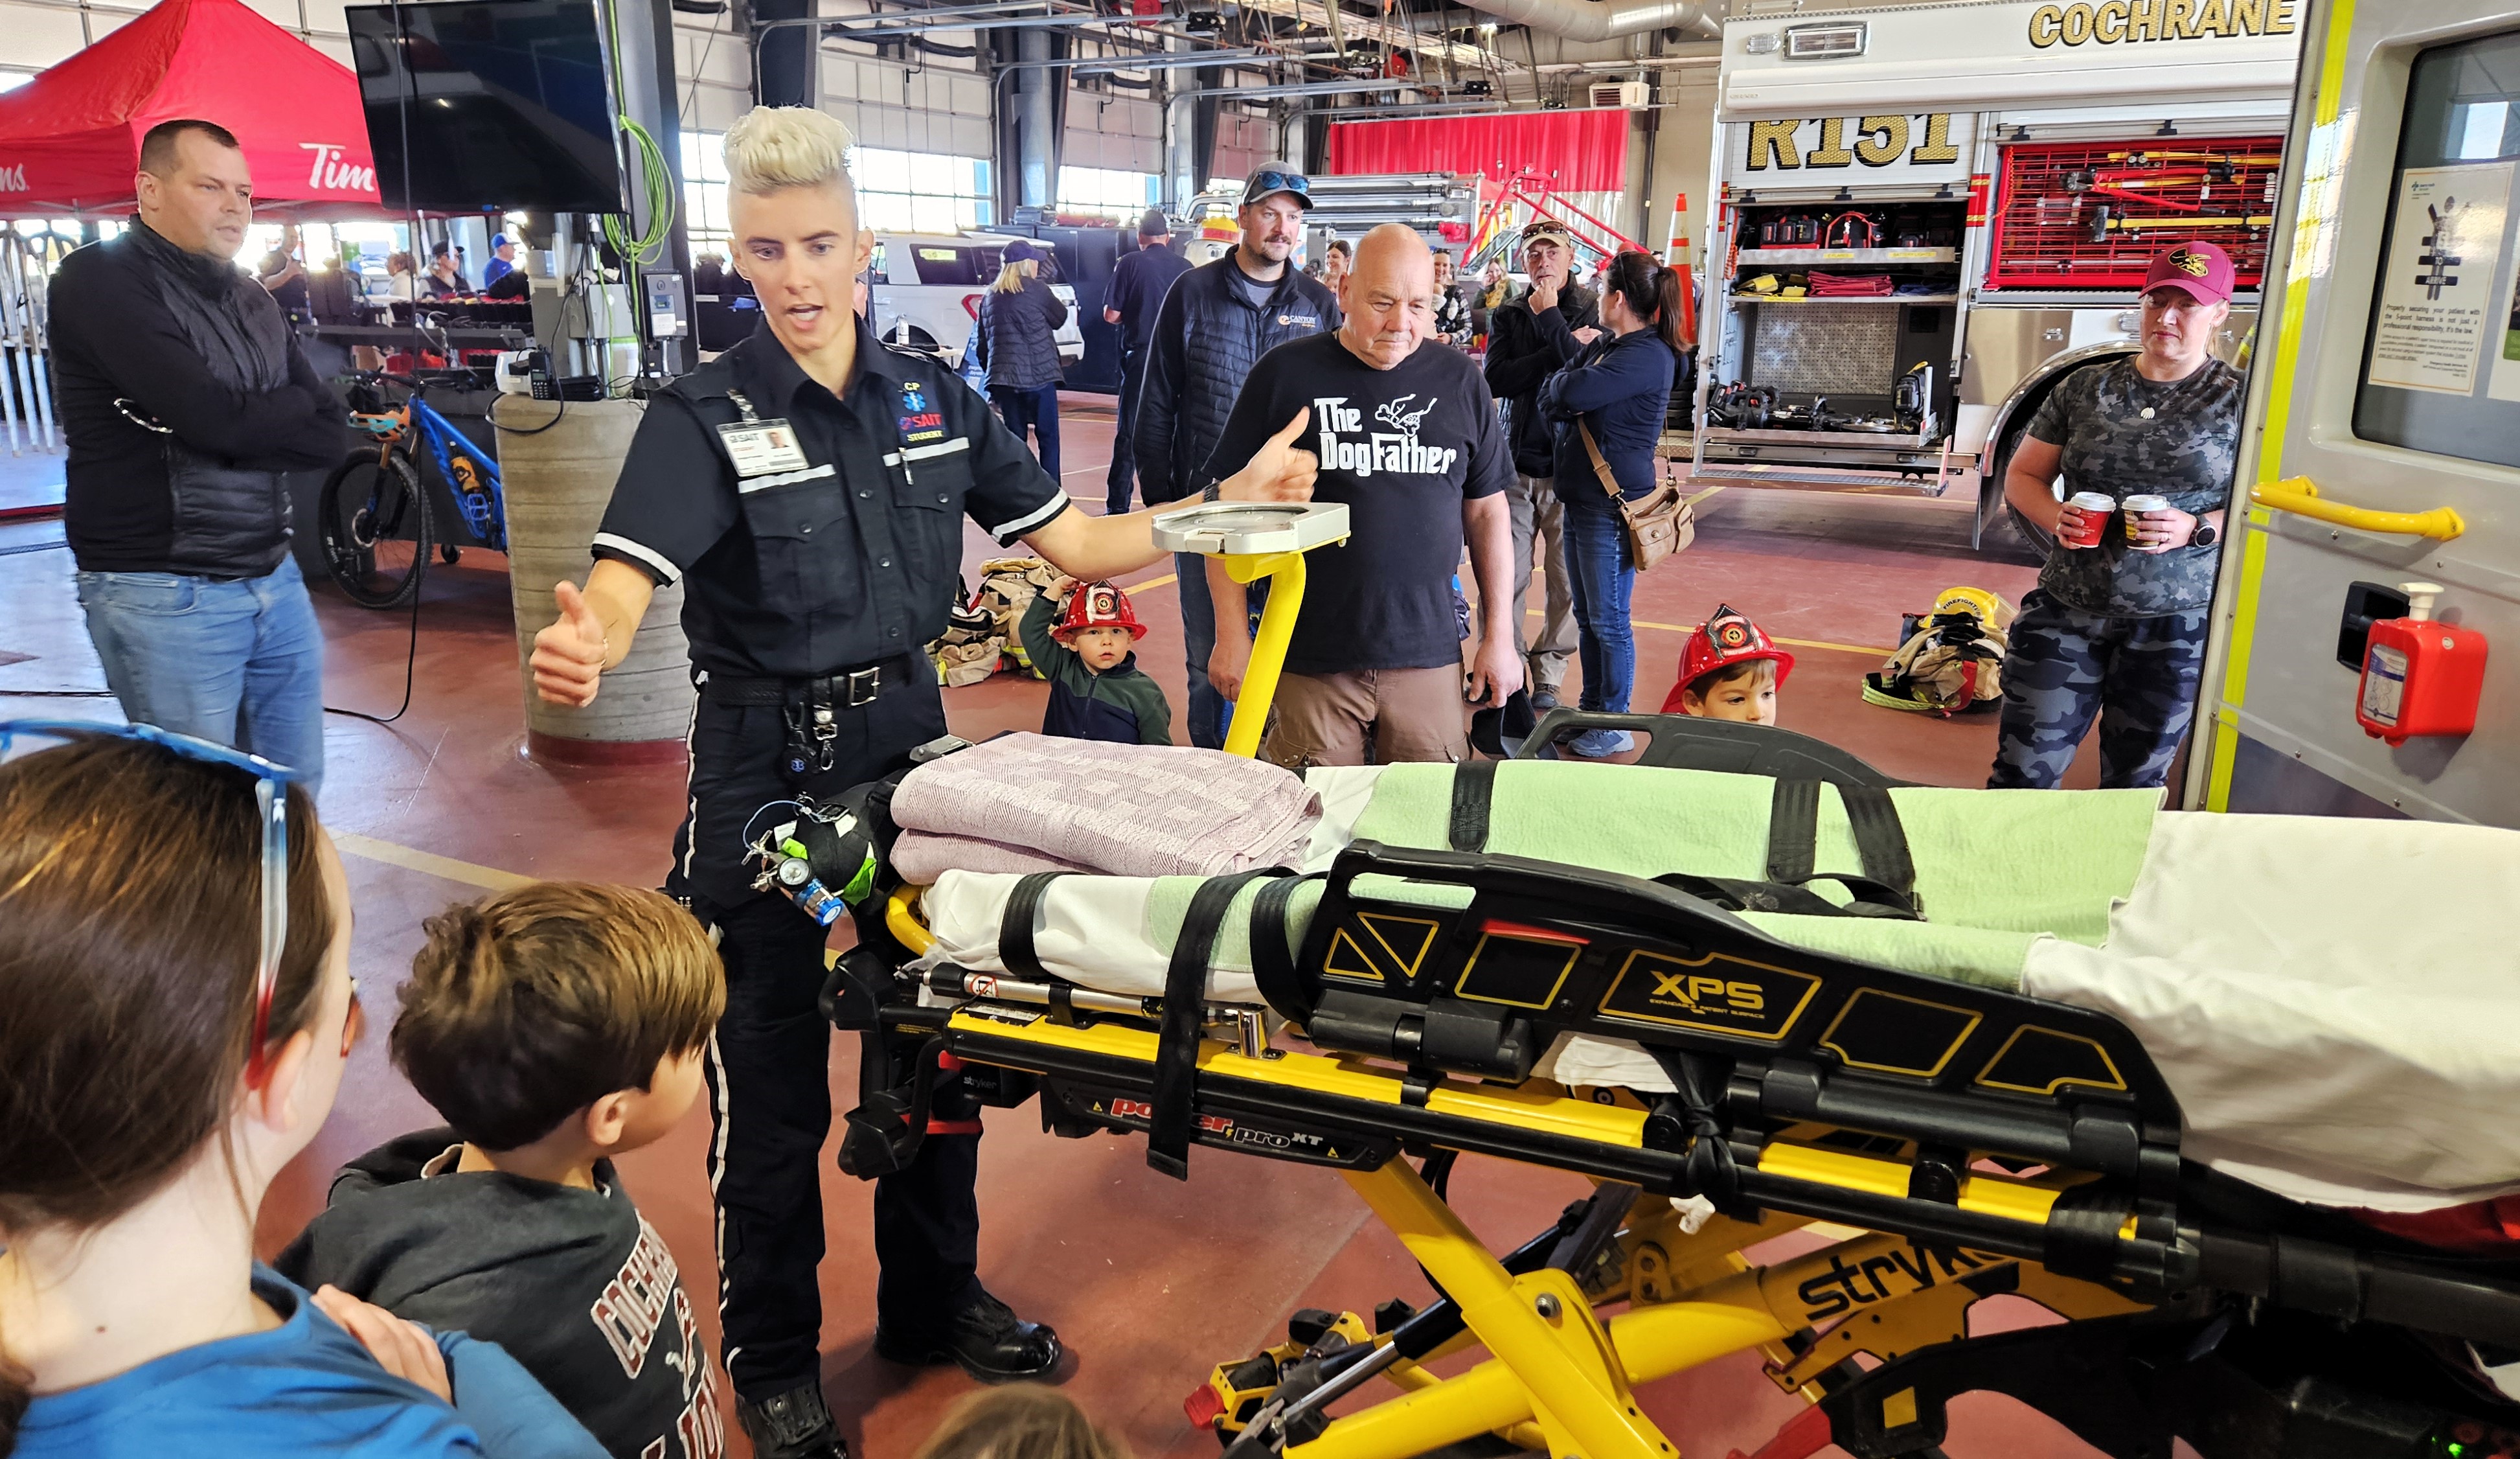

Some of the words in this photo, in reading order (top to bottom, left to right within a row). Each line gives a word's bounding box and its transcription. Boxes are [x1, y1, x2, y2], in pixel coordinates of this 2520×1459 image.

[2029, 0, 2295, 49] COCHRANE
[1746, 113, 1959, 172] R151
[298, 142, 375, 192] Tim
[2425, 276, 2447, 285] ARRIVE
[2386, 303, 2405, 312] Properly
[2383, 321, 2411, 330] professional
[904, 382, 920, 391] CP
[911, 413, 942, 428] SAIT
[1313, 397, 1363, 433] The
[907, 430, 944, 441] STUDENT
[1319, 432, 1457, 477] DogFather
[1650, 971, 1764, 1012] XPS
[963, 1075, 997, 1090] stryker
[1233, 1127, 1291, 1149] pro
[1291, 1132, 1323, 1146] XT
